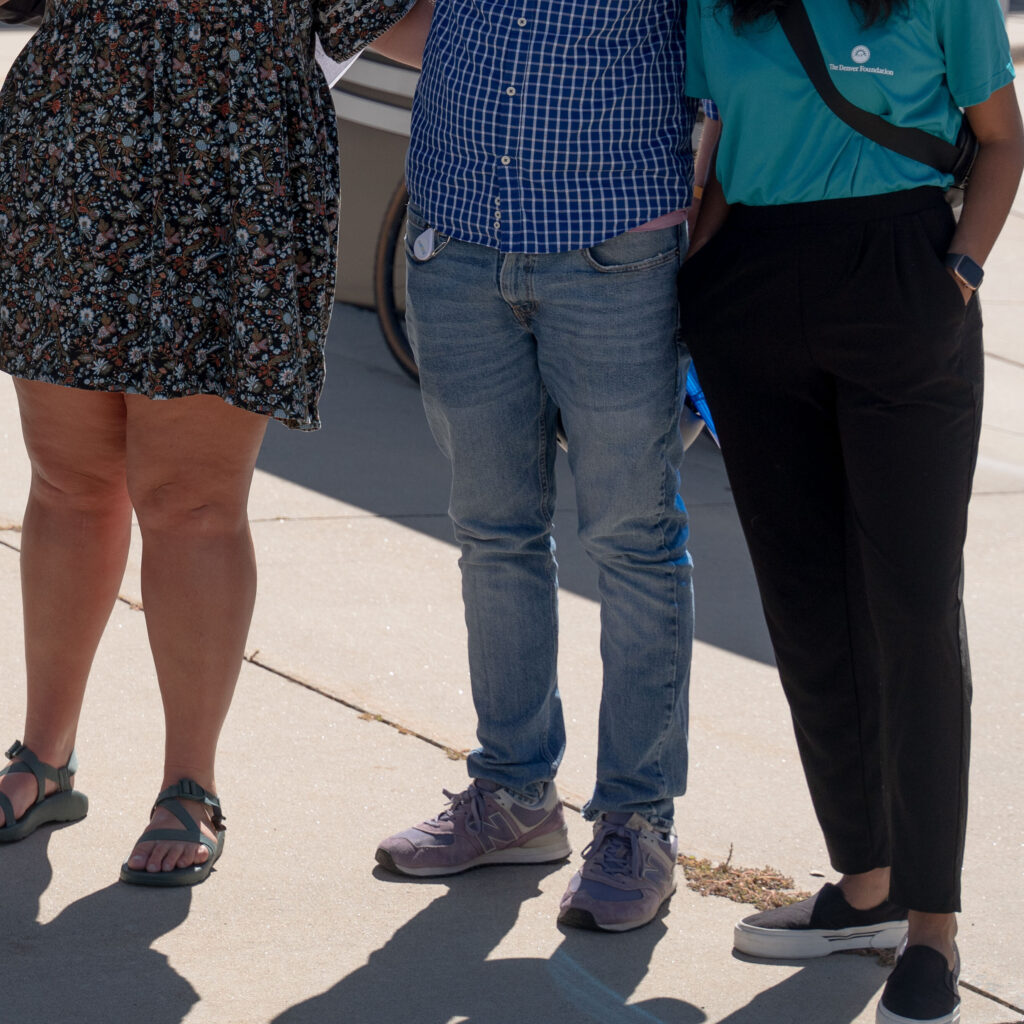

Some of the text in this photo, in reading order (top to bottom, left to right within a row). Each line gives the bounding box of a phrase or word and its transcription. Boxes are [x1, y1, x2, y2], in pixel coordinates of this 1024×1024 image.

[829, 63, 894, 76] The Denver Foundation
